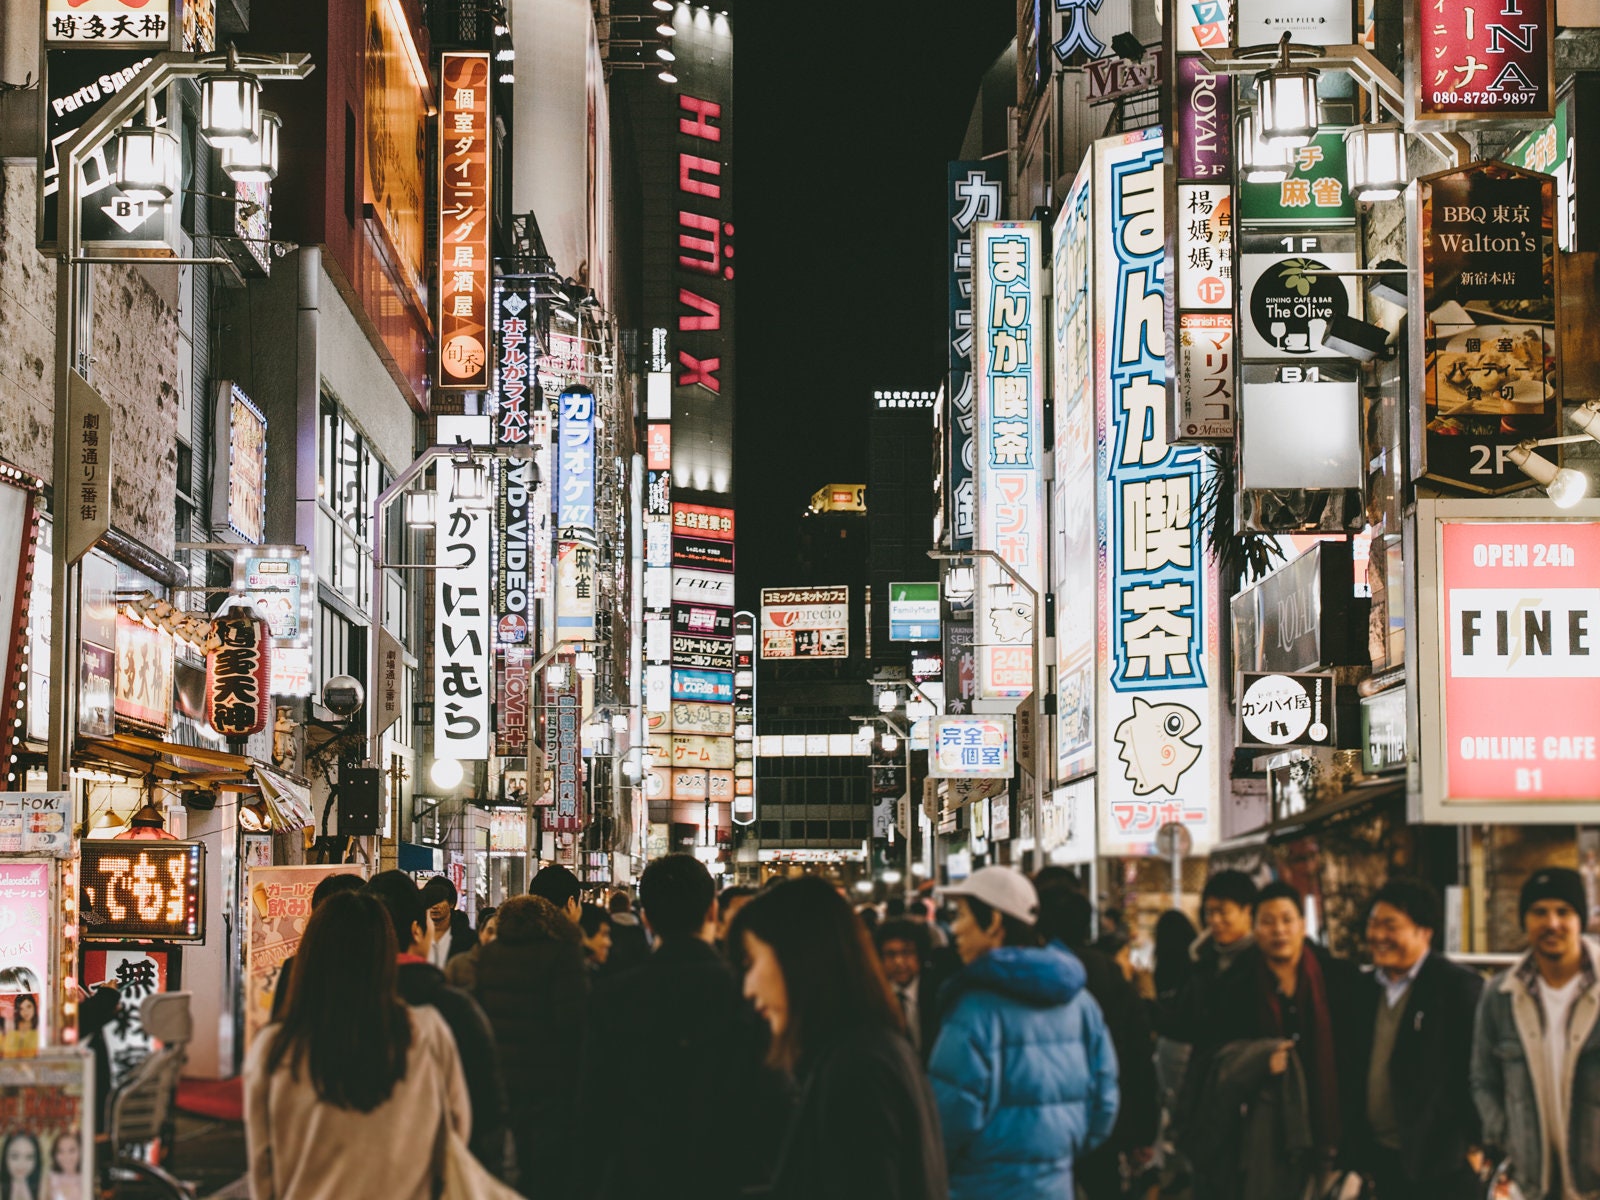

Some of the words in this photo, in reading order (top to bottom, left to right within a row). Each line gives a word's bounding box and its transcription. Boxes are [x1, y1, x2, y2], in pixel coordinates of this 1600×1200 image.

[52, 14, 167, 39] 博多天神
[52, 79, 100, 118] Party
[1432, 91, 1536, 105] 080-8720-9897
[1190, 73, 1217, 162] ROYAL
[1194, 165, 1225, 176] 2F
[453, 88, 475, 317] 個室ダイニング居酒屋
[1280, 178, 1342, 208] 麻雀
[116, 200, 144, 218] B1
[1443, 207, 1487, 224] BBQ
[1491, 205, 1530, 224] 東京
[1187, 190, 1213, 271] 楊媽媽
[1281, 237, 1317, 252] 1F
[1439, 232, 1536, 253] Walton's
[1460, 272, 1516, 286] 新宿本店
[1199, 283, 1224, 301] 1F
[1180, 316, 1216, 328] Spanish
[1266, 304, 1291, 318] The
[1293, 303, 1333, 319] Olive
[990, 236, 1031, 467] まんが喫茶
[1465, 338, 1513, 353] 個室
[1201, 332, 1231, 421] マリスコ
[1282, 367, 1319, 382] B1
[1451, 363, 1530, 375] パーティー
[500, 317, 528, 445] ホテルがライバル
[563, 393, 592, 502] カラオケ
[80, 413, 100, 521] 劇場通り一番街
[1469, 444, 1513, 475] 2F
[561, 504, 591, 522] 747
[674, 510, 732, 532] 全店営業中
[1473, 544, 1528, 567] OPEN
[1533, 544, 1575, 567] 24h
[575, 547, 591, 599] 麻雀
[675, 577, 732, 591] FACE
[441, 435, 484, 740] かつにいむら
[893, 605, 937, 614] FamilyMart
[1461, 610, 1590, 656] FINE
[942, 727, 983, 746] 完全
[961, 747, 1001, 766] 個室
[1460, 736, 1536, 760] ONLINE
[1543, 736, 1597, 760] CAFE
[1515, 769, 1542, 792] B1
